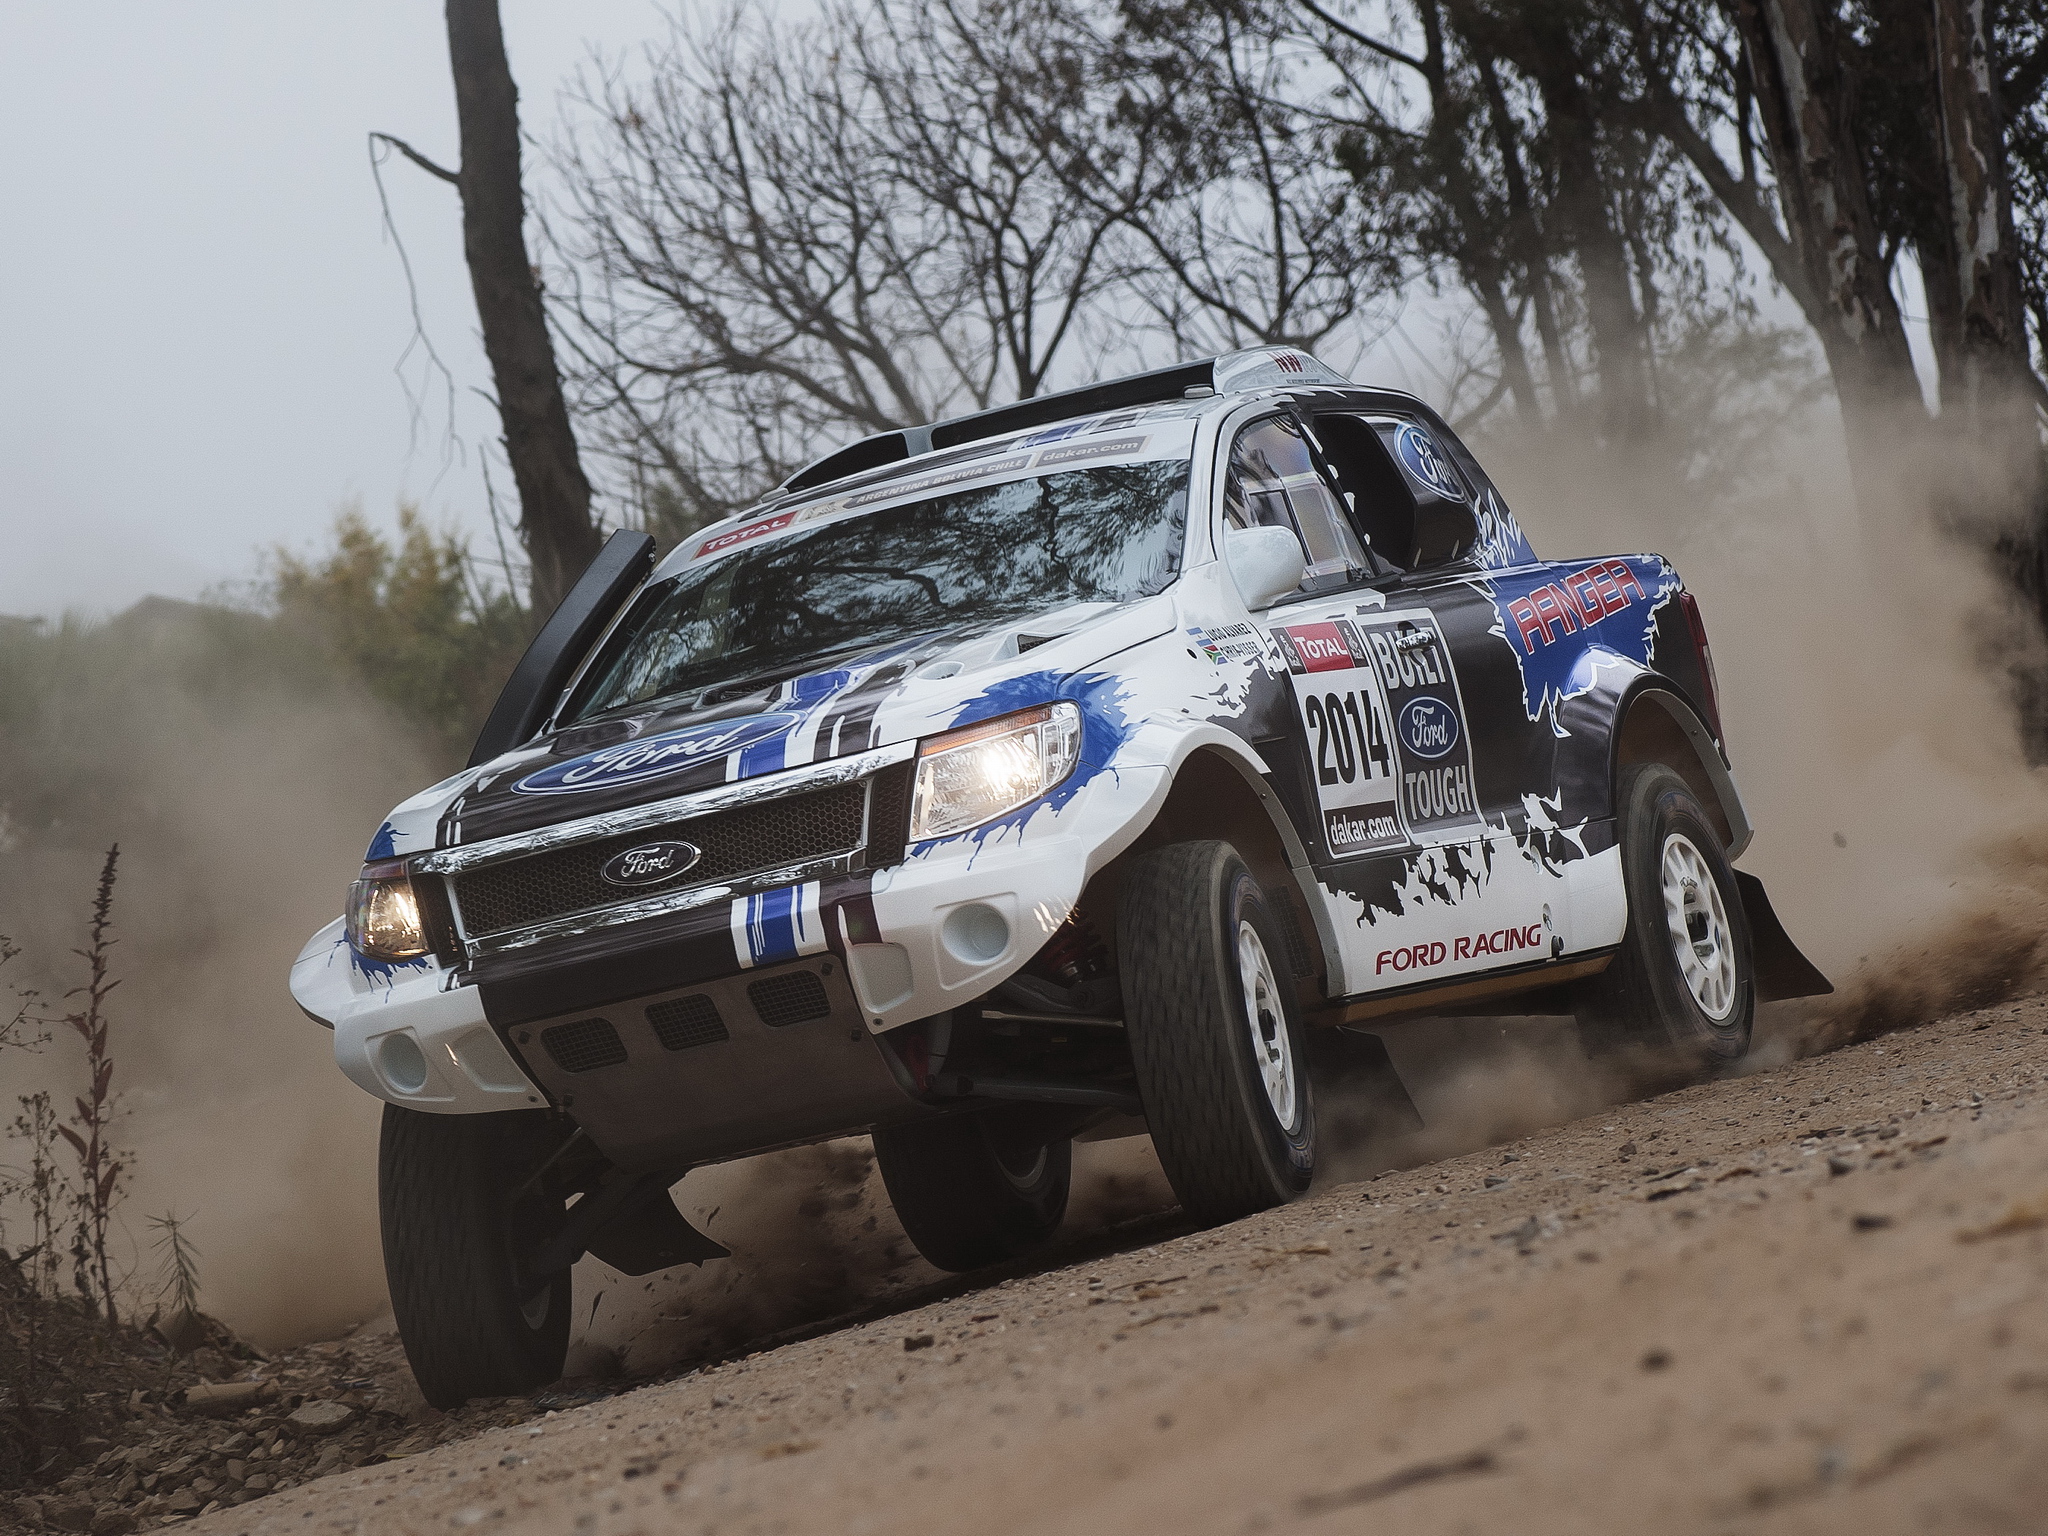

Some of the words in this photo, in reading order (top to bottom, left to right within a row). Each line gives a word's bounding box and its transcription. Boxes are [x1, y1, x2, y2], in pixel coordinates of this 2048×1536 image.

[1043, 442, 1139, 461] dakar.com
[1410, 431, 1454, 485] Ford
[856, 481, 929, 503] ARGENTINA
[932, 468, 983, 485] BOLIVIA
[986, 459, 1025, 472] CHILE
[706, 520, 786, 550] TOTAL
[1507, 558, 1646, 655] RANGER
[1293, 636, 1348, 659] TOTAL
[1305, 689, 1391, 786] 2014
[1412, 705, 1449, 748] Ford
[561, 722, 753, 784] Ford
[1405, 765, 1472, 820] TOUGH
[1330, 814, 1399, 846] dakar.com
[621, 847, 674, 878] Ford
[1375, 941, 1447, 975] FORD
[1453, 923, 1542, 961] RACING
